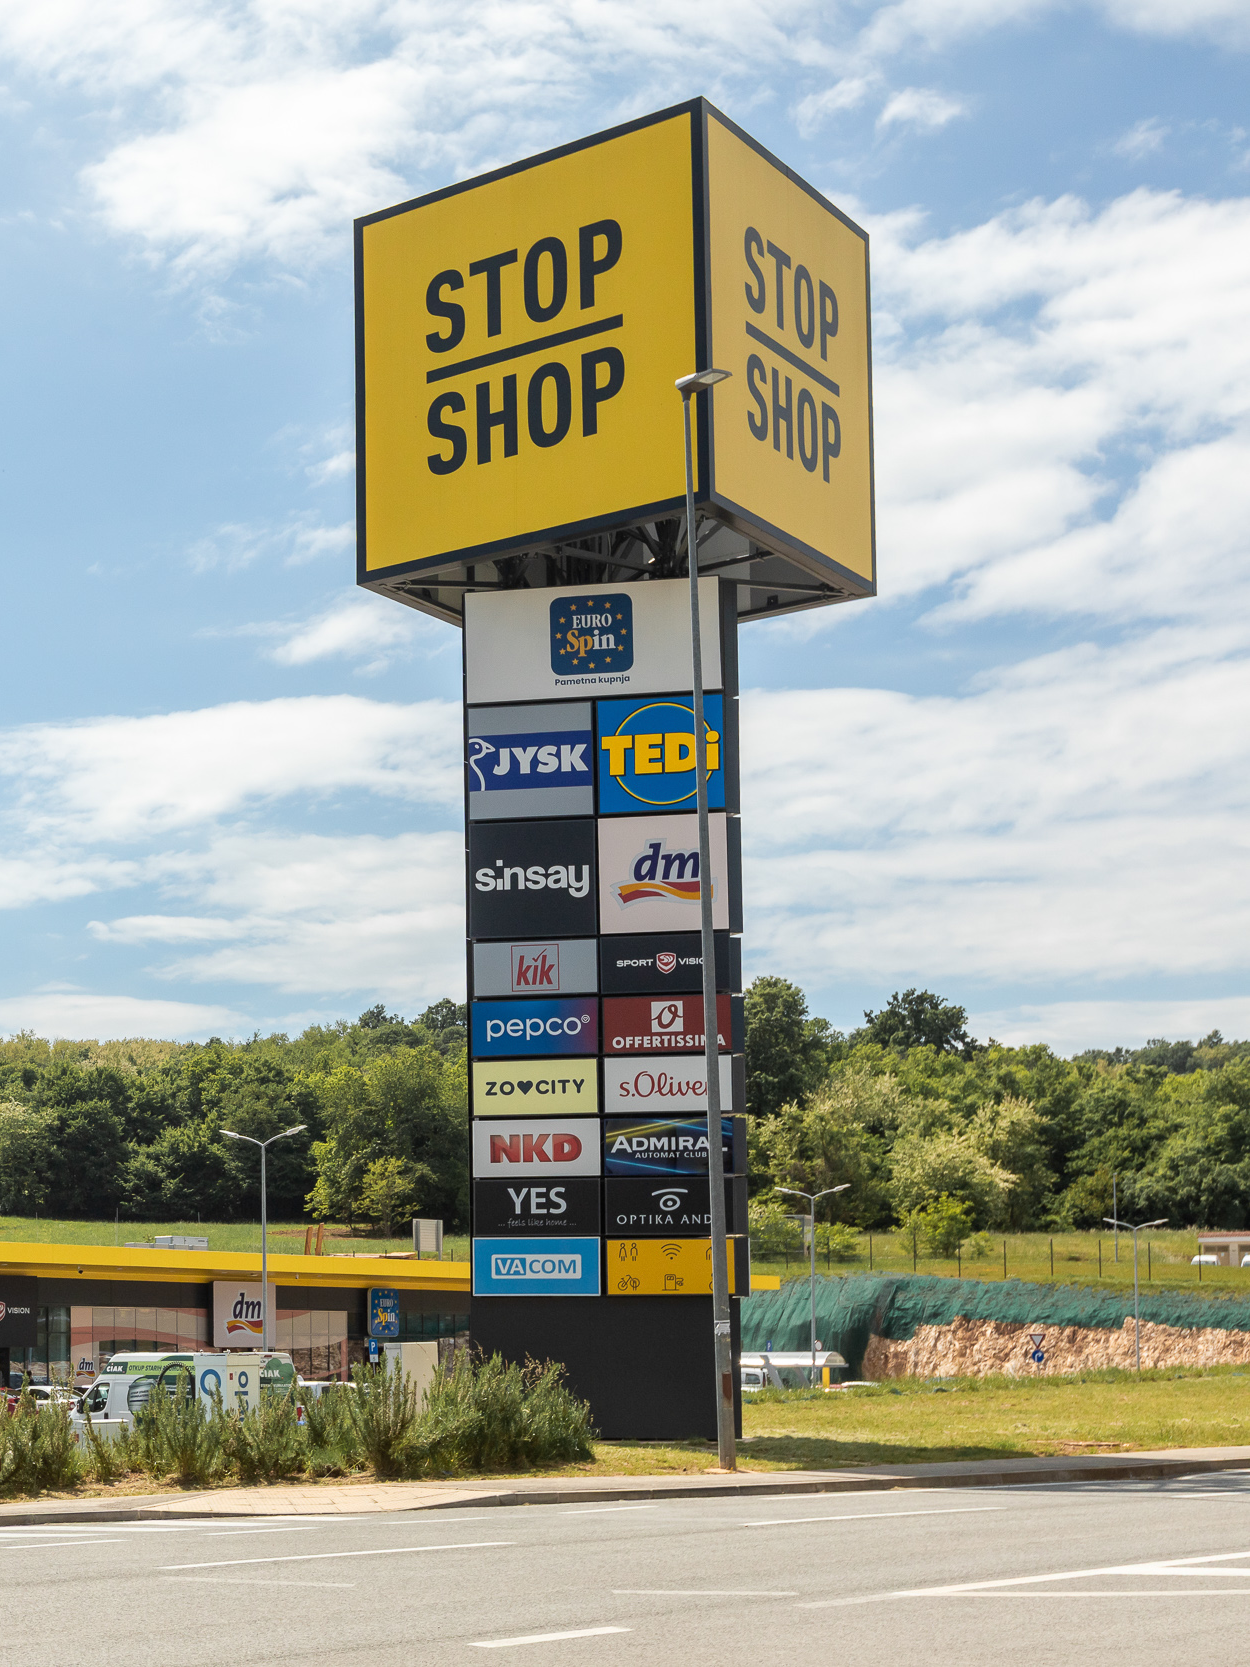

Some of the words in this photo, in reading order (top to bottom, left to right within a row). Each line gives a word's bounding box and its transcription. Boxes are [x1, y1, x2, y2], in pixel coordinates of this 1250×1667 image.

[425, 219, 623, 353] STOP
[744, 226, 839, 362] STOP
[426, 346, 625, 475] SHOP
[746, 353, 841, 483] SHOP
[572, 613, 612, 628] EURO
[566, 629, 616, 657] Spin
[555, 676, 597, 686] Pametna
[598, 674, 630, 685] kupnja
[493, 744, 589, 776] JYSK
[601, 730, 720, 777] TEDi
[633, 843, 701, 882] dm
[475, 859, 590, 898] sinsay
[516, 948, 556, 986] kik
[616, 959, 653, 968] SPORT
[486, 1016, 582, 1042] pepco
[489, 1133, 582, 1164] NKD
[610, 1135, 728, 1153] ADMIRA
[507, 1187, 567, 1214] YES
[507, 1217, 526, 1229] feels
[527, 1218, 544, 1226] like
[545, 1218, 567, 1226] home
[616, 1214, 673, 1225] OPTIKA
[496, 1259, 577, 1274] VACOM
[232, 1292, 262, 1319] dm
[377, 1308, 395, 1326] Spin
[370, 1341, 376, 1352] P
[78, 1357, 94, 1371] dm
[145, 1364, 163, 1372] STARIH
